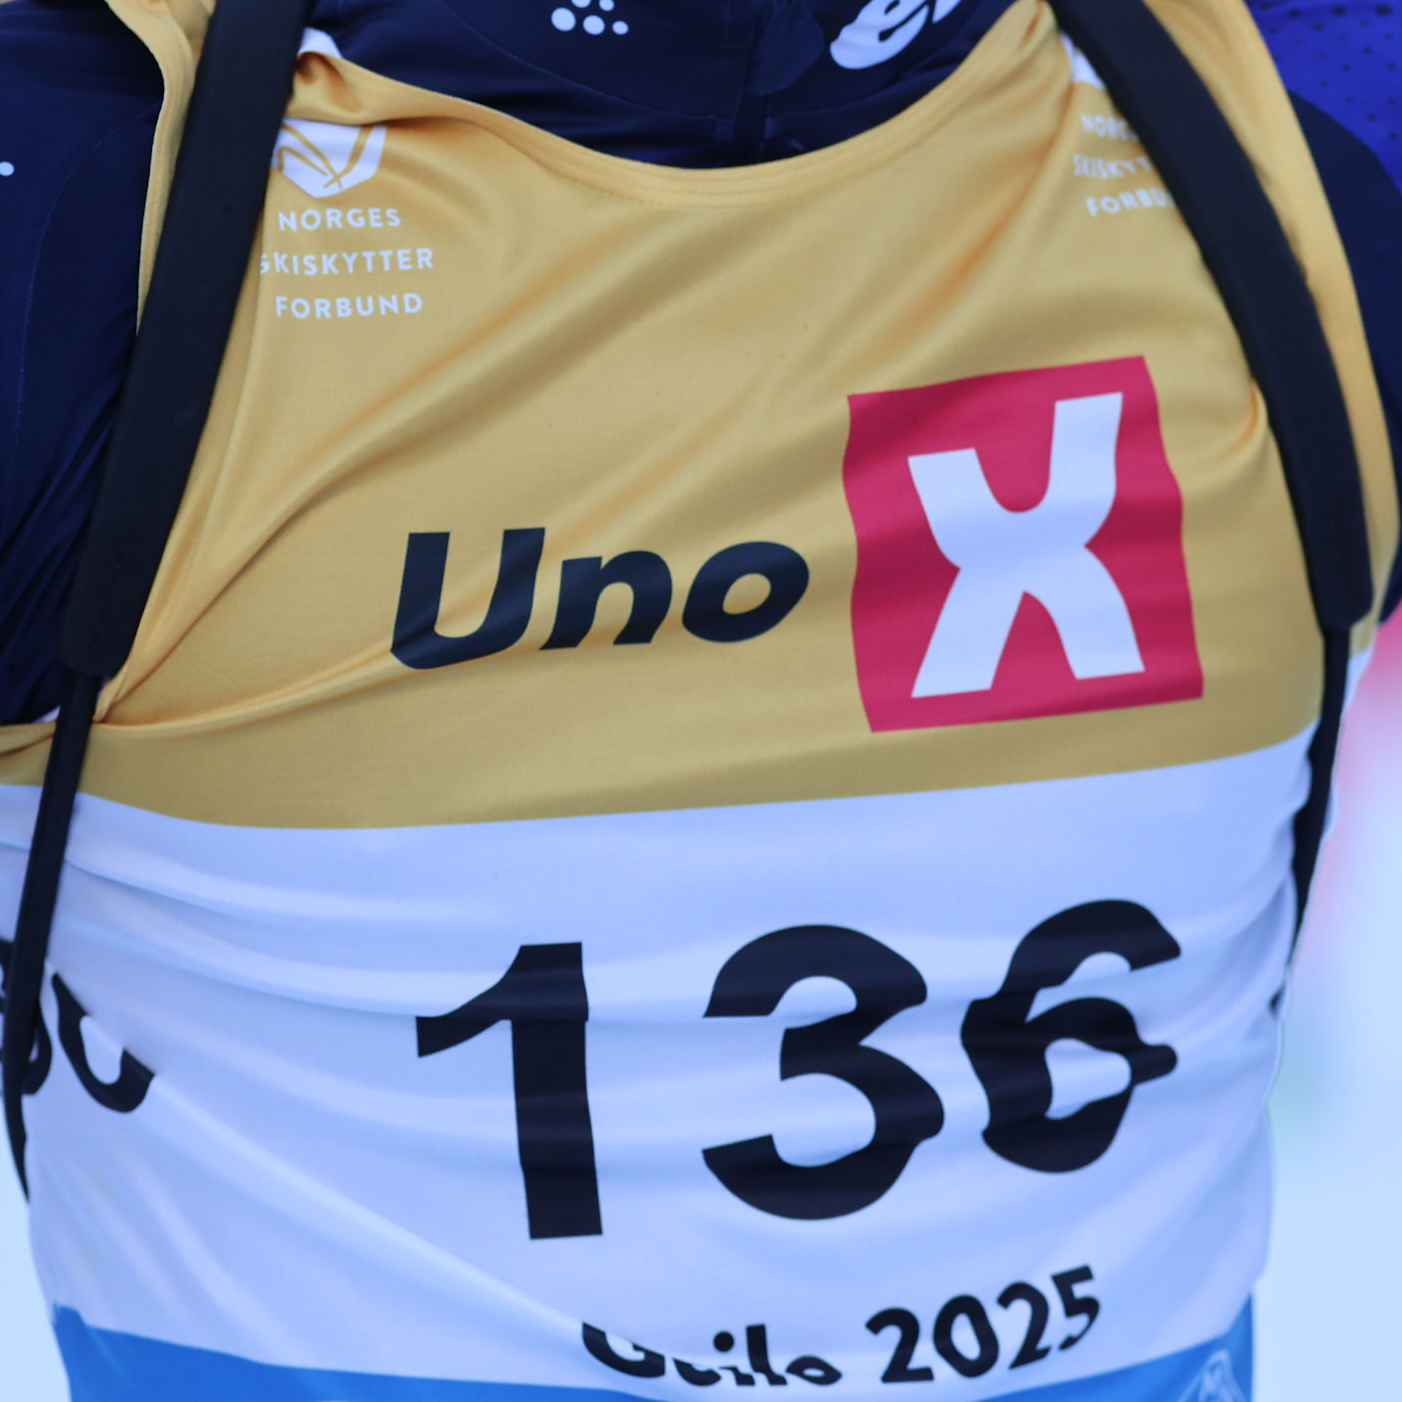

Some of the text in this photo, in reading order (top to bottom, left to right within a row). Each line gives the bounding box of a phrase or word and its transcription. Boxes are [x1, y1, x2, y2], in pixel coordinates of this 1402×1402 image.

[277, 207, 402, 232] NORGES
[259, 247, 435, 277] SKISKYTTER
[275, 292, 424, 319] FORBUND
[390, 391, 1147, 699] Uno X
[415, 898, 1183, 1241] 136
[864, 1264, 1101, 1385] 2025
